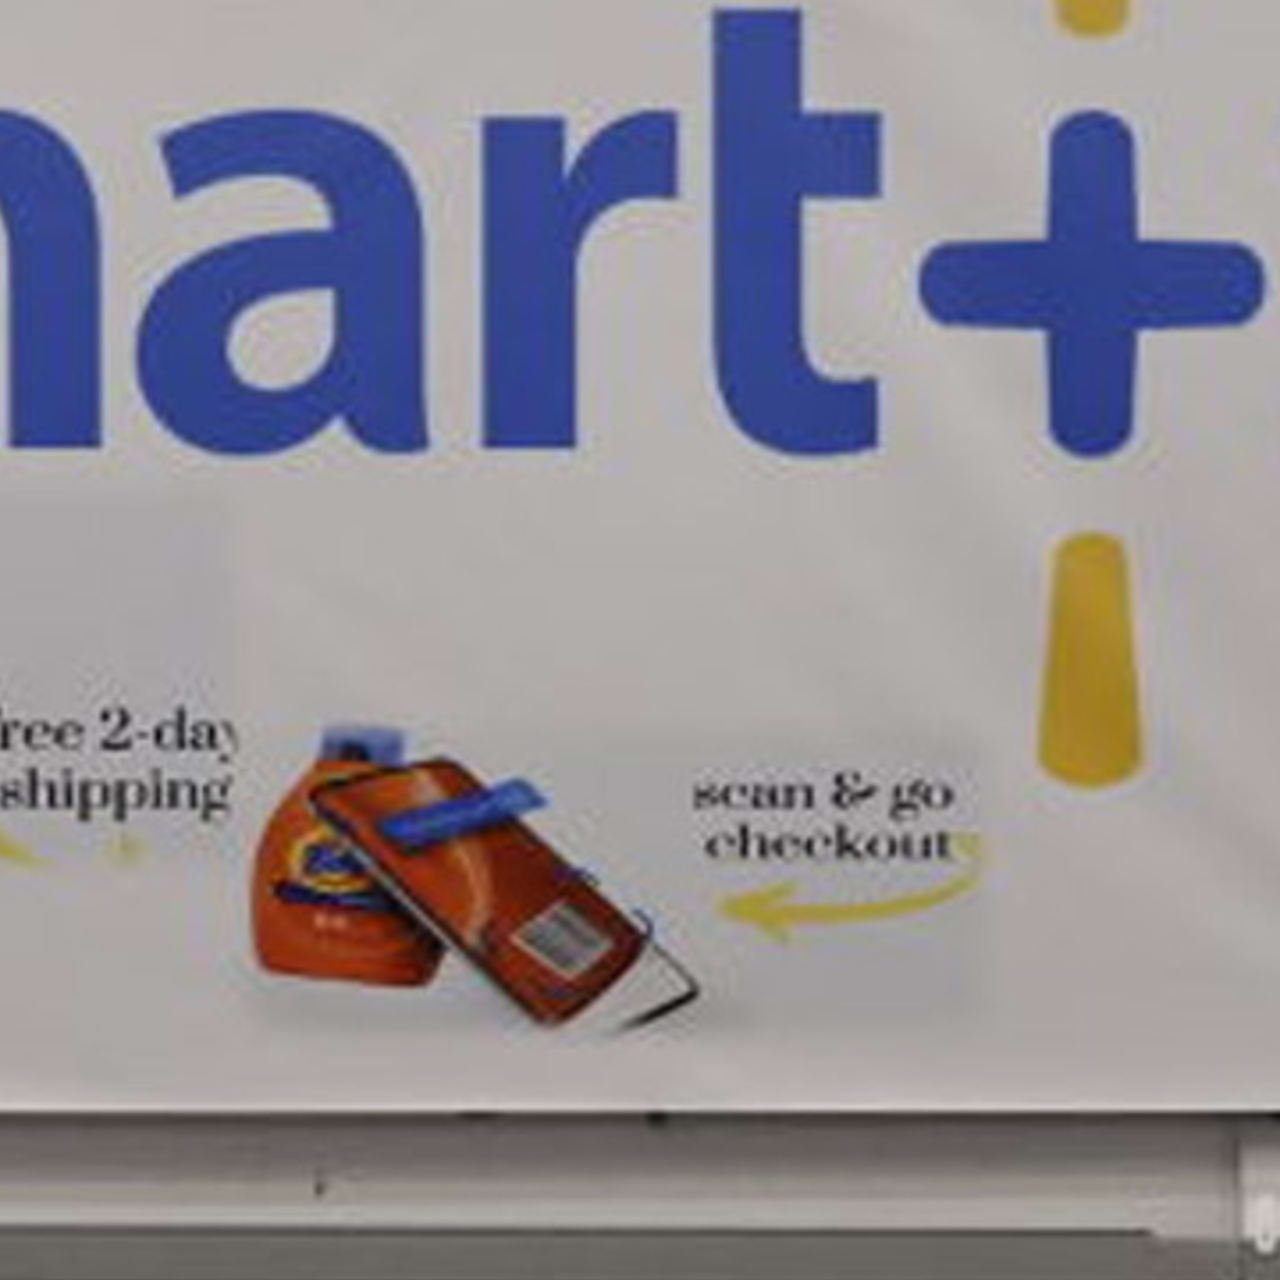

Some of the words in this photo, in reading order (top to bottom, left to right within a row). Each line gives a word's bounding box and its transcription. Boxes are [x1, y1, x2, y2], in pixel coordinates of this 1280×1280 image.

[693, 783, 816, 811] scan
[830, 772, 878, 810] &
[889, 779, 955, 821] go
[703, 824, 957, 860] checkout
